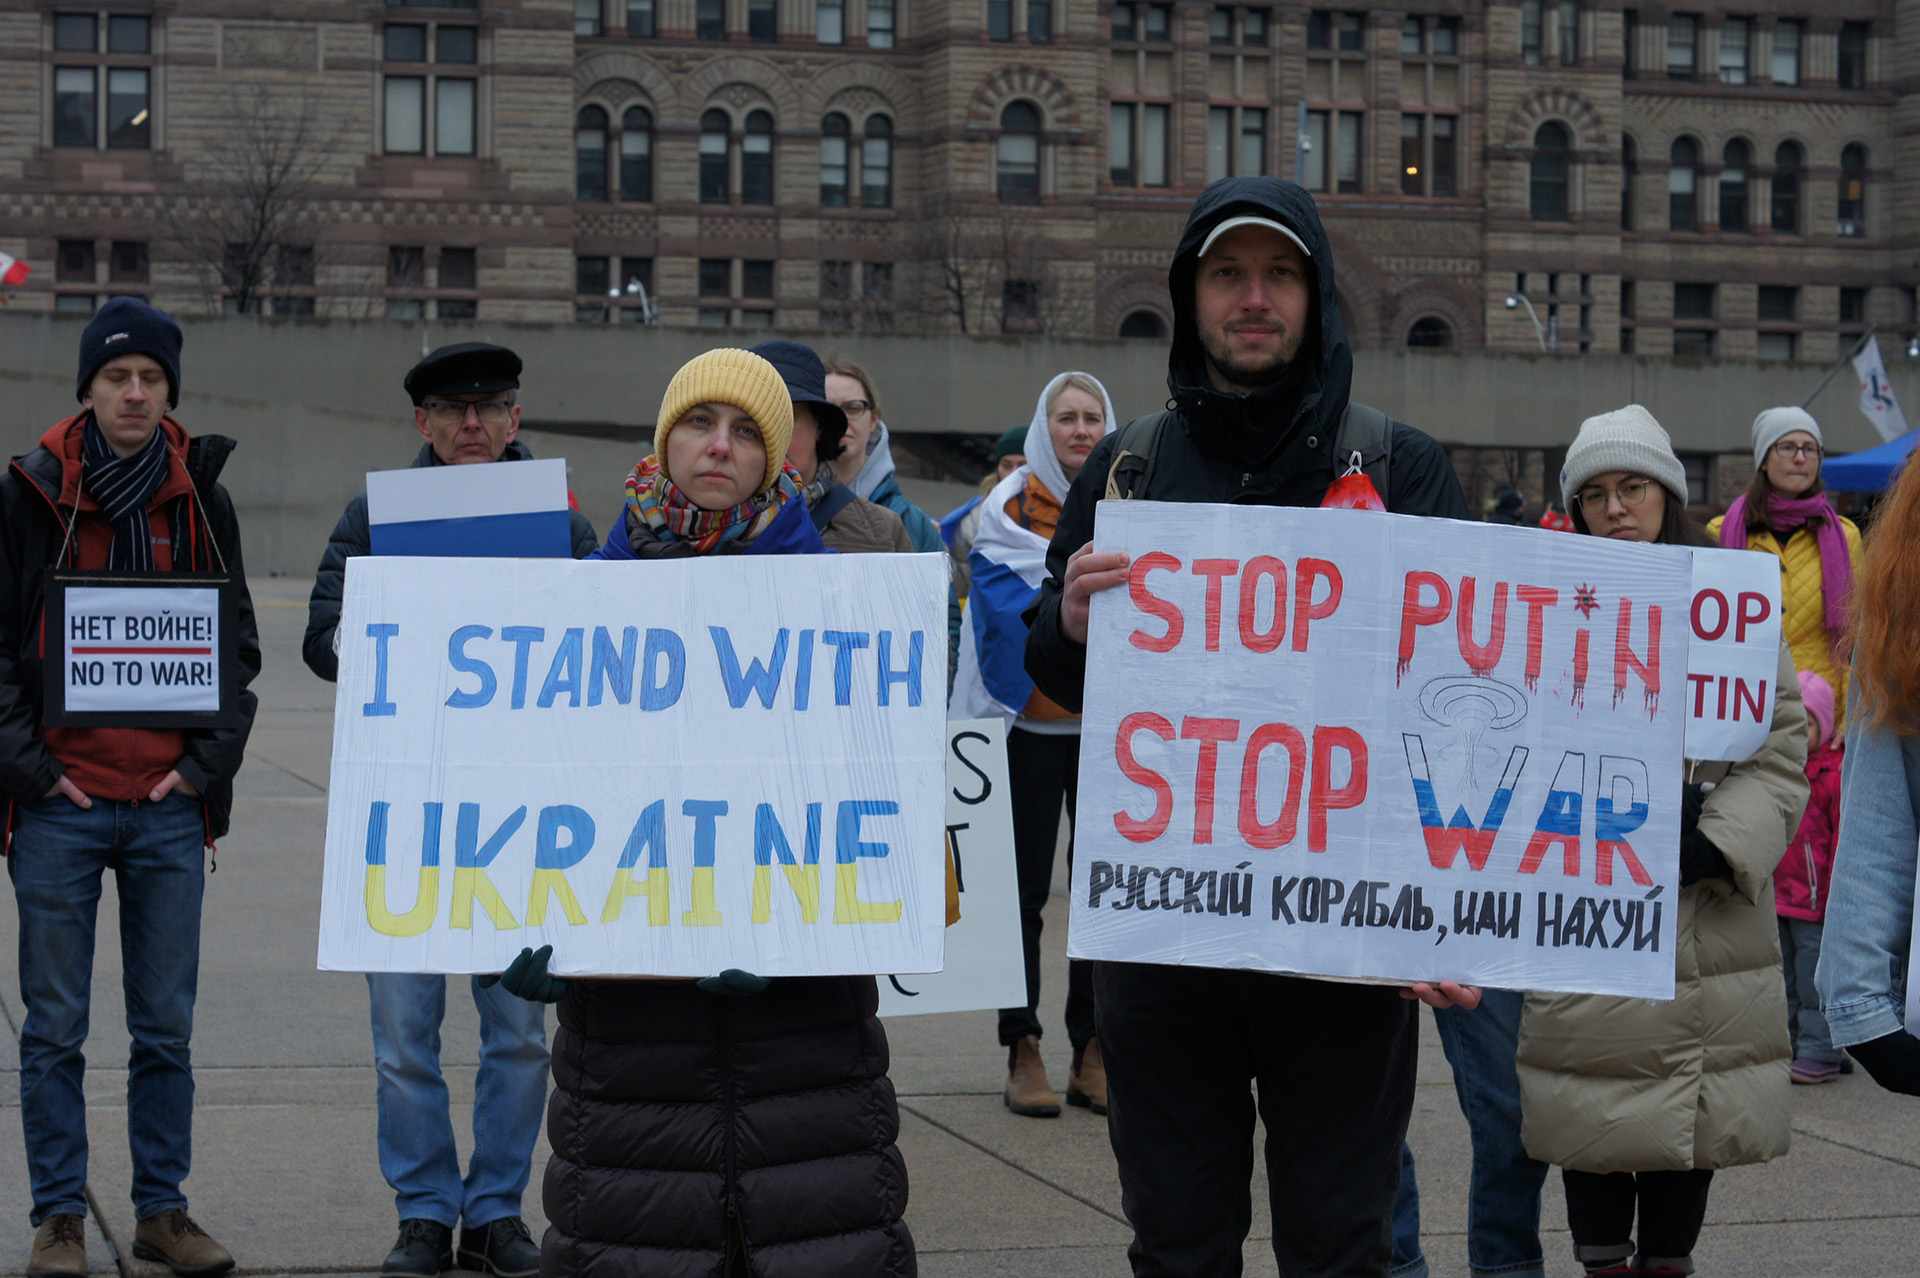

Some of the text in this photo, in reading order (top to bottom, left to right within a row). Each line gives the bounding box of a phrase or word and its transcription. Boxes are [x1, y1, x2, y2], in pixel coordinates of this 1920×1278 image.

[70, 609, 212, 641] НЕТ ВОЙНЕ!
[1127, 551, 1344, 653] STOP
[1690, 588, 1771, 643] OP
[71, 661, 212, 687] NO TO WAR!
[363, 623, 924, 717] I STAND WITH
[1687, 673, 1767, 723] TIN
[1113, 711, 1654, 887] STOP WAR
[364, 799, 902, 937] UKRAINE
[1088, 861, 1665, 952] РУССКИЙ КОРАБЛЬ, ИДИ НАХУЙ
